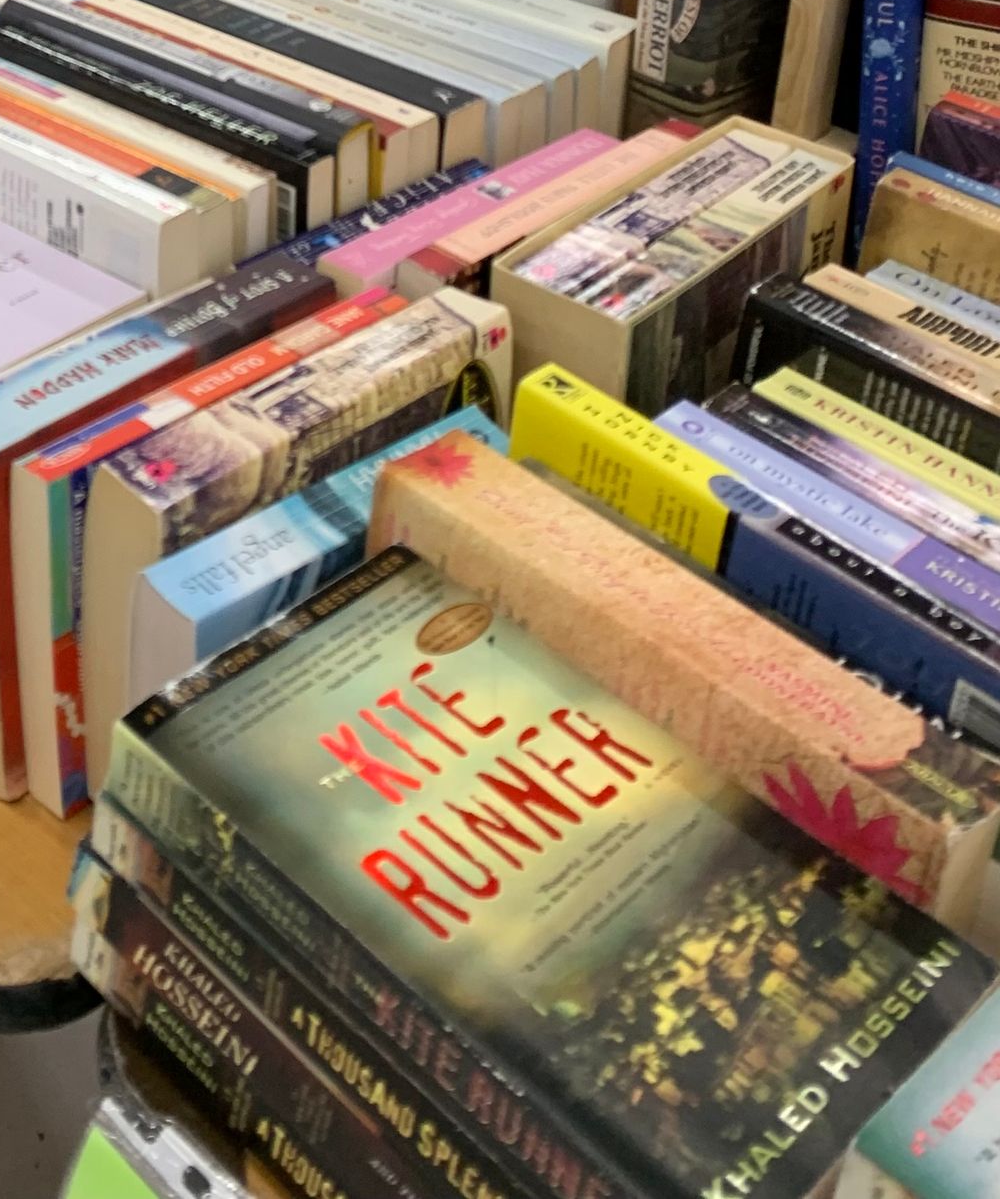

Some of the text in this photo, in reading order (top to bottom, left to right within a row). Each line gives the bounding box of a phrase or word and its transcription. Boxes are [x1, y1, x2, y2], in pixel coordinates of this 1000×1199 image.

[872, 70, 889, 127] ALICE
[12, 335, 162, 410] MARK HADDON
[583, 405, 695, 474] HORNBY
[614, 411, 682, 452] NICK
[812, 398, 915, 457] KRISTIN
[728, 443, 888, 538] on mystic lake
[179, 527, 296, 597] angel falls
[791, 523, 983, 644] about boy
[212, 554, 409, 684] YORK BESTSELLER
[317, 660, 509, 806] KITE
[357, 708, 654, 943] RUNNER
[132, 943, 260, 1077] HOSSEINI
[163, 941, 242, 1023] KHALED
[817, 936, 962, 1082] HOSSEINI
[308, 1011, 417, 1138] THOUSAND
[374, 984, 463, 1092] KITE
[702, 1085, 829, 1199] KHALED
